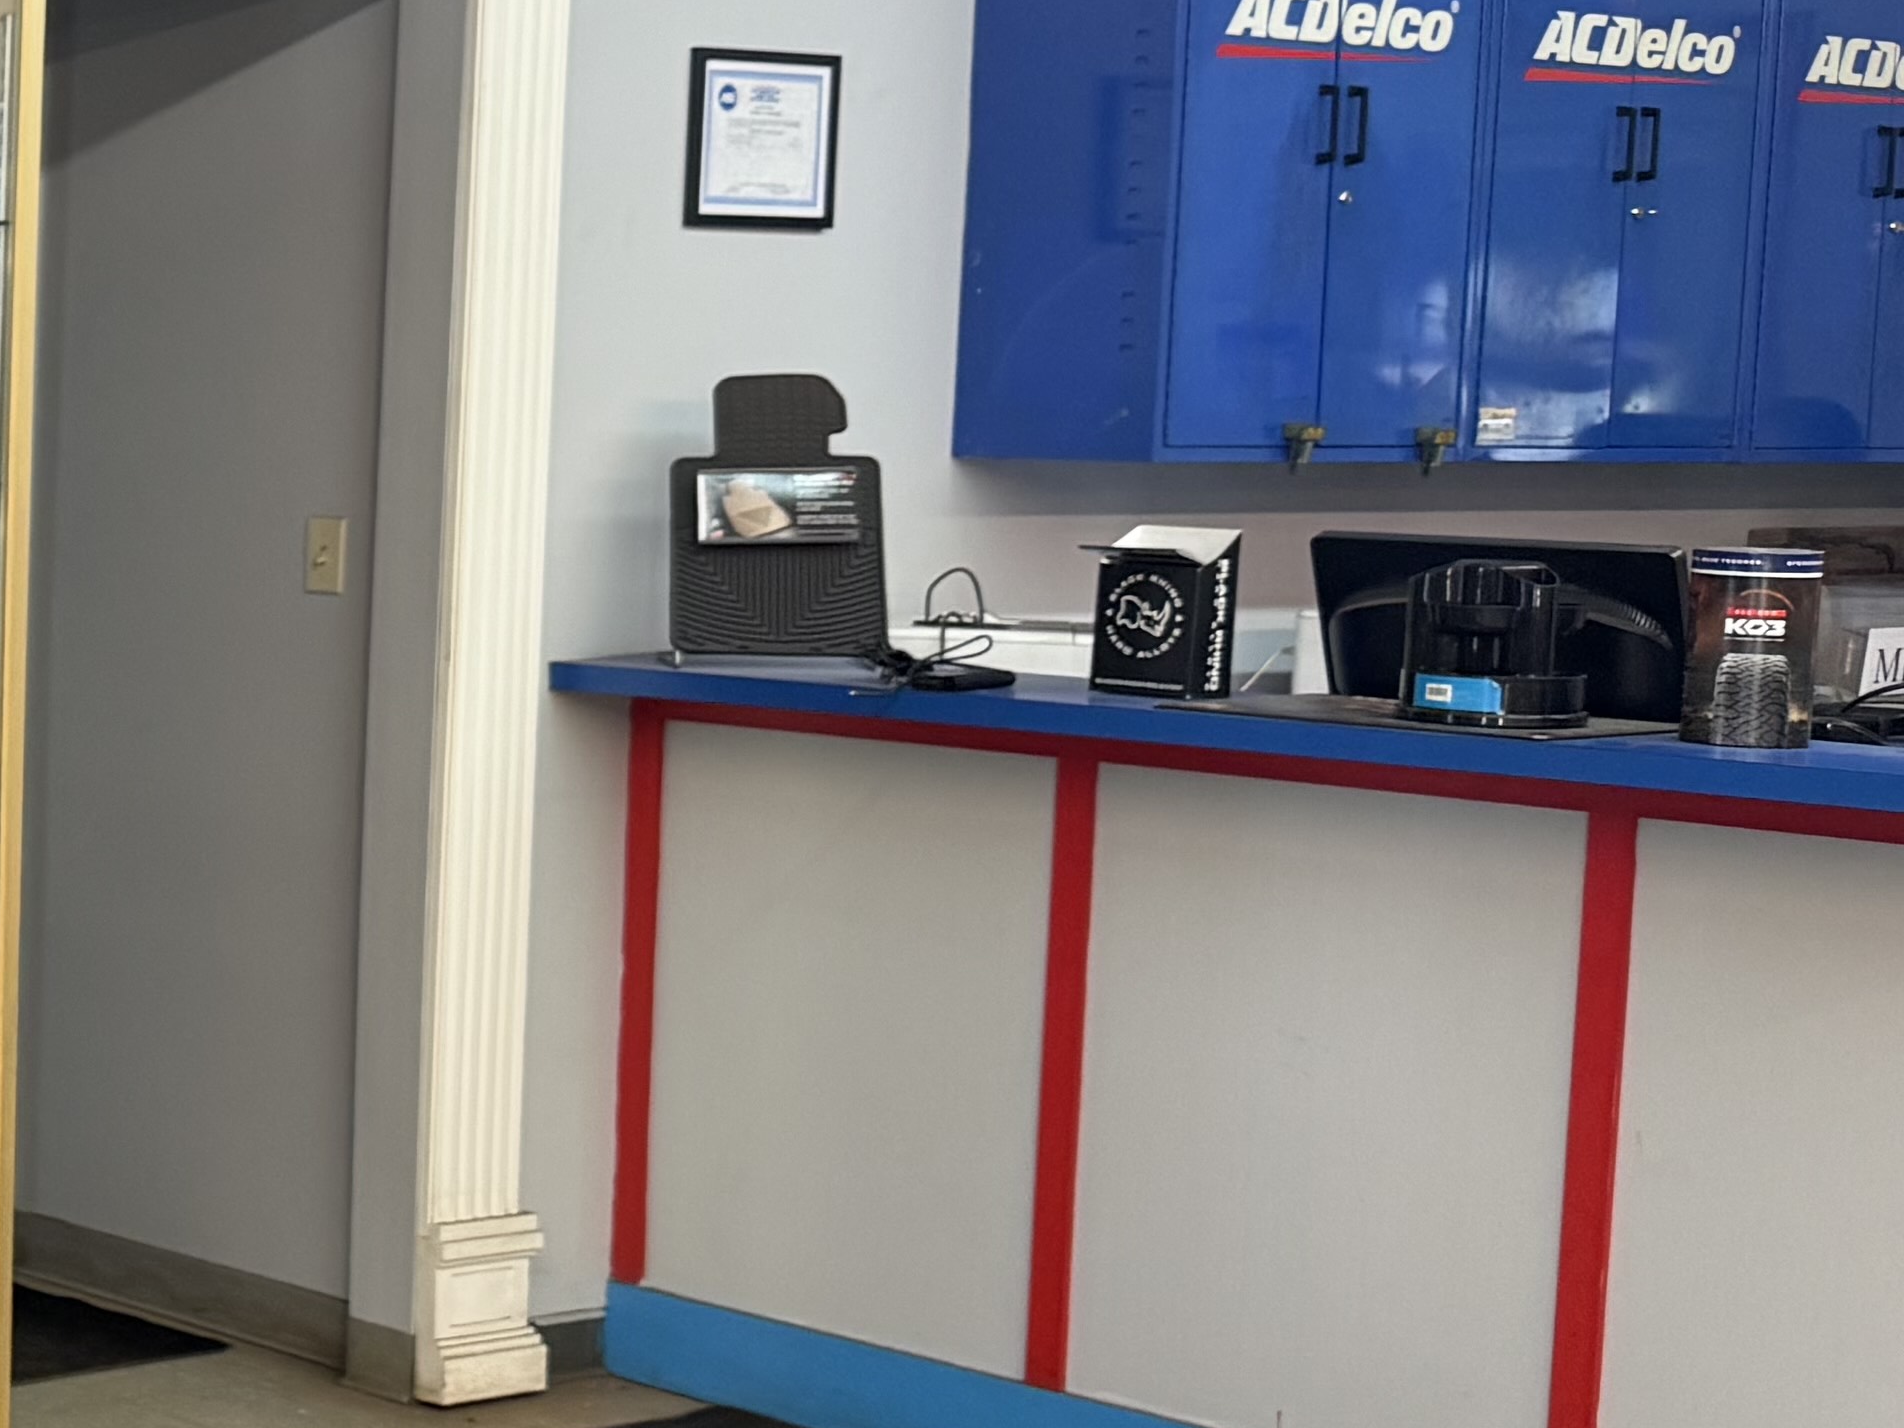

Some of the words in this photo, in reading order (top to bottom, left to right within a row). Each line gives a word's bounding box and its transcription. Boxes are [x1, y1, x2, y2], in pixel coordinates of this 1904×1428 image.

[1533, 10, 1739, 76] ACDelco
[1806, 35, 1904, 90] ACD
[1724, 618, 1787, 637] KO3
